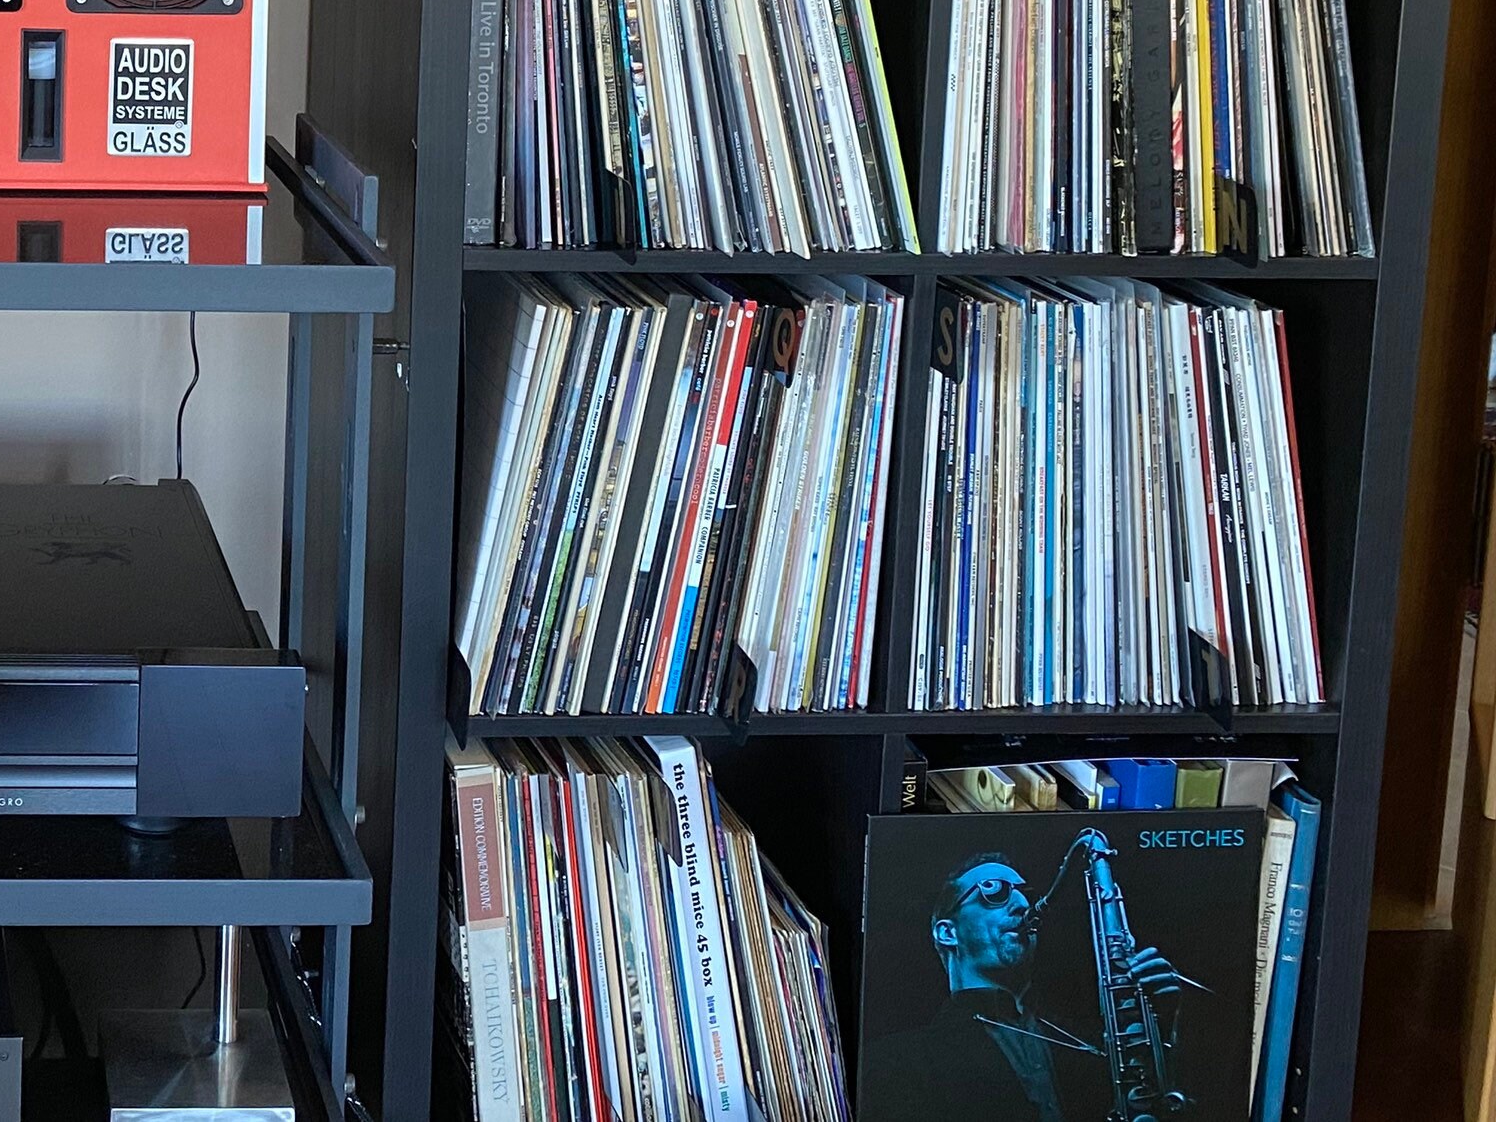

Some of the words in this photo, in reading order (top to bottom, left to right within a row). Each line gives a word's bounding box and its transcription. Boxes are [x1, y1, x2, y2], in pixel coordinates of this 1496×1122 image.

[479, 2, 496, 37] Live
[117, 48, 186, 73] AUDIO
[479, 41, 495, 58] in
[116, 77, 184, 102] DESK
[475, 61, 494, 134] Toronto
[115, 105, 185, 120] SYSTEME
[113, 127, 186, 154] GLÄSS
[637, 333, 646, 350] FLOYD
[641, 322, 649, 333] PINK
[937, 307, 955, 366] S
[772, 310, 796, 374] Q
[607, 388, 615, 401] floyd
[1235, 373, 1247, 419] CONSUMMATION
[1241, 423, 1249, 436] THAD
[1242, 437, 1251, 458] JONES
[799, 450, 810, 478] GOLDEN
[709, 468, 720, 495] PATRICIA
[794, 480, 805, 510] STRIKER
[1220, 474, 1230, 502] TARKAN
[704, 497, 715, 521] BARBER
[695, 526, 708, 564] COMPANION
[925, 541, 930, 551] GO
[672, 762, 686, 791] the
[901, 774, 917, 808] Welt
[677, 795, 691, 839] three
[1139, 828, 1245, 848] SKETCHES
[685, 843, 700, 887] blind
[1266, 862, 1283, 899] Franco
[690, 891, 704, 929] mice
[1258, 902, 1276, 949] Magnani
[696, 931, 708, 954] 45
[700, 957, 713, 987] box
[706, 995, 714, 1015] blow
[481, 957, 511, 1103] TCHAIKOWSKY
[709, 1017, 716, 1028] up
[711, 1030, 723, 1064] midnight
[720, 1092, 730, 1112] misty
